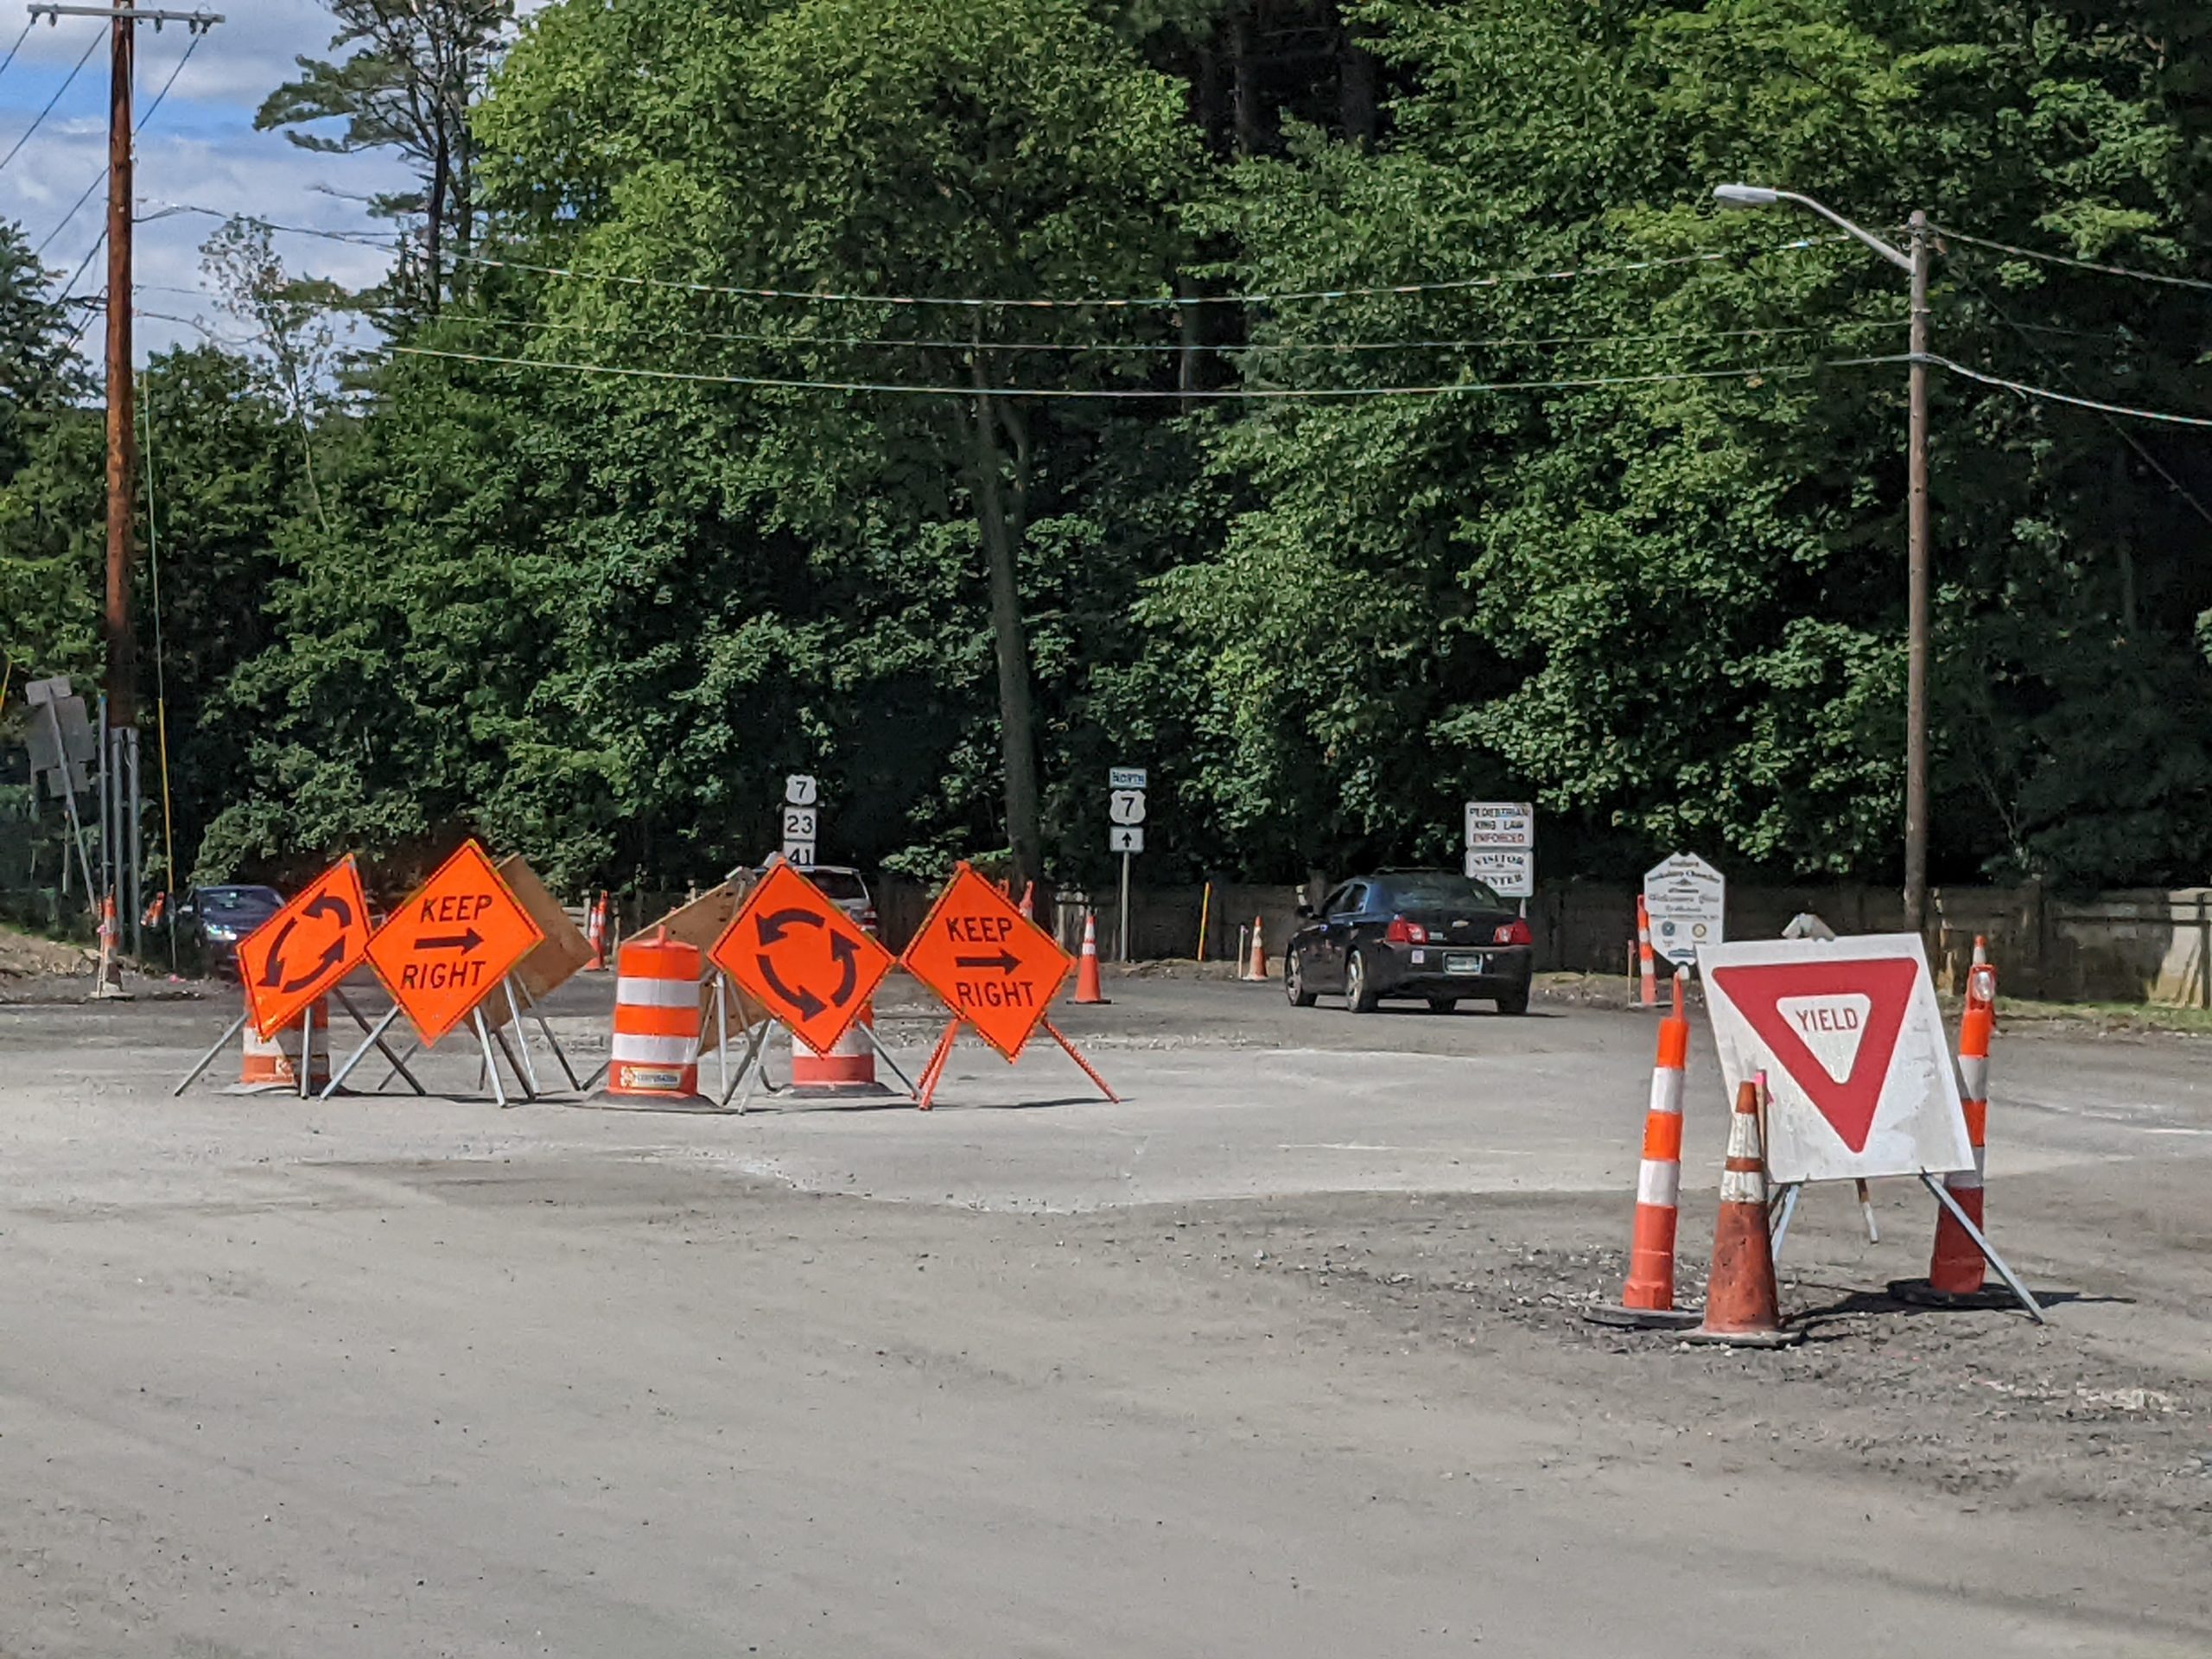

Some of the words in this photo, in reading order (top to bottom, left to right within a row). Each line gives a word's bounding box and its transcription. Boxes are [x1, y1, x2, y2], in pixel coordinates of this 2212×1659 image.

[796, 781, 807, 799] 7
[1121, 797, 1135, 817] 7
[787, 815, 813, 834] 23
[789, 848, 810, 866] 41
[1474, 854, 1524, 866] VISITOR
[420, 894, 493, 924] KEEP
[945, 917, 1013, 942] KEEP
[400, 961, 486, 990] RIGHT
[956, 982, 1033, 1007] RIGHT
[1796, 1007, 1858, 1032] YIELD
